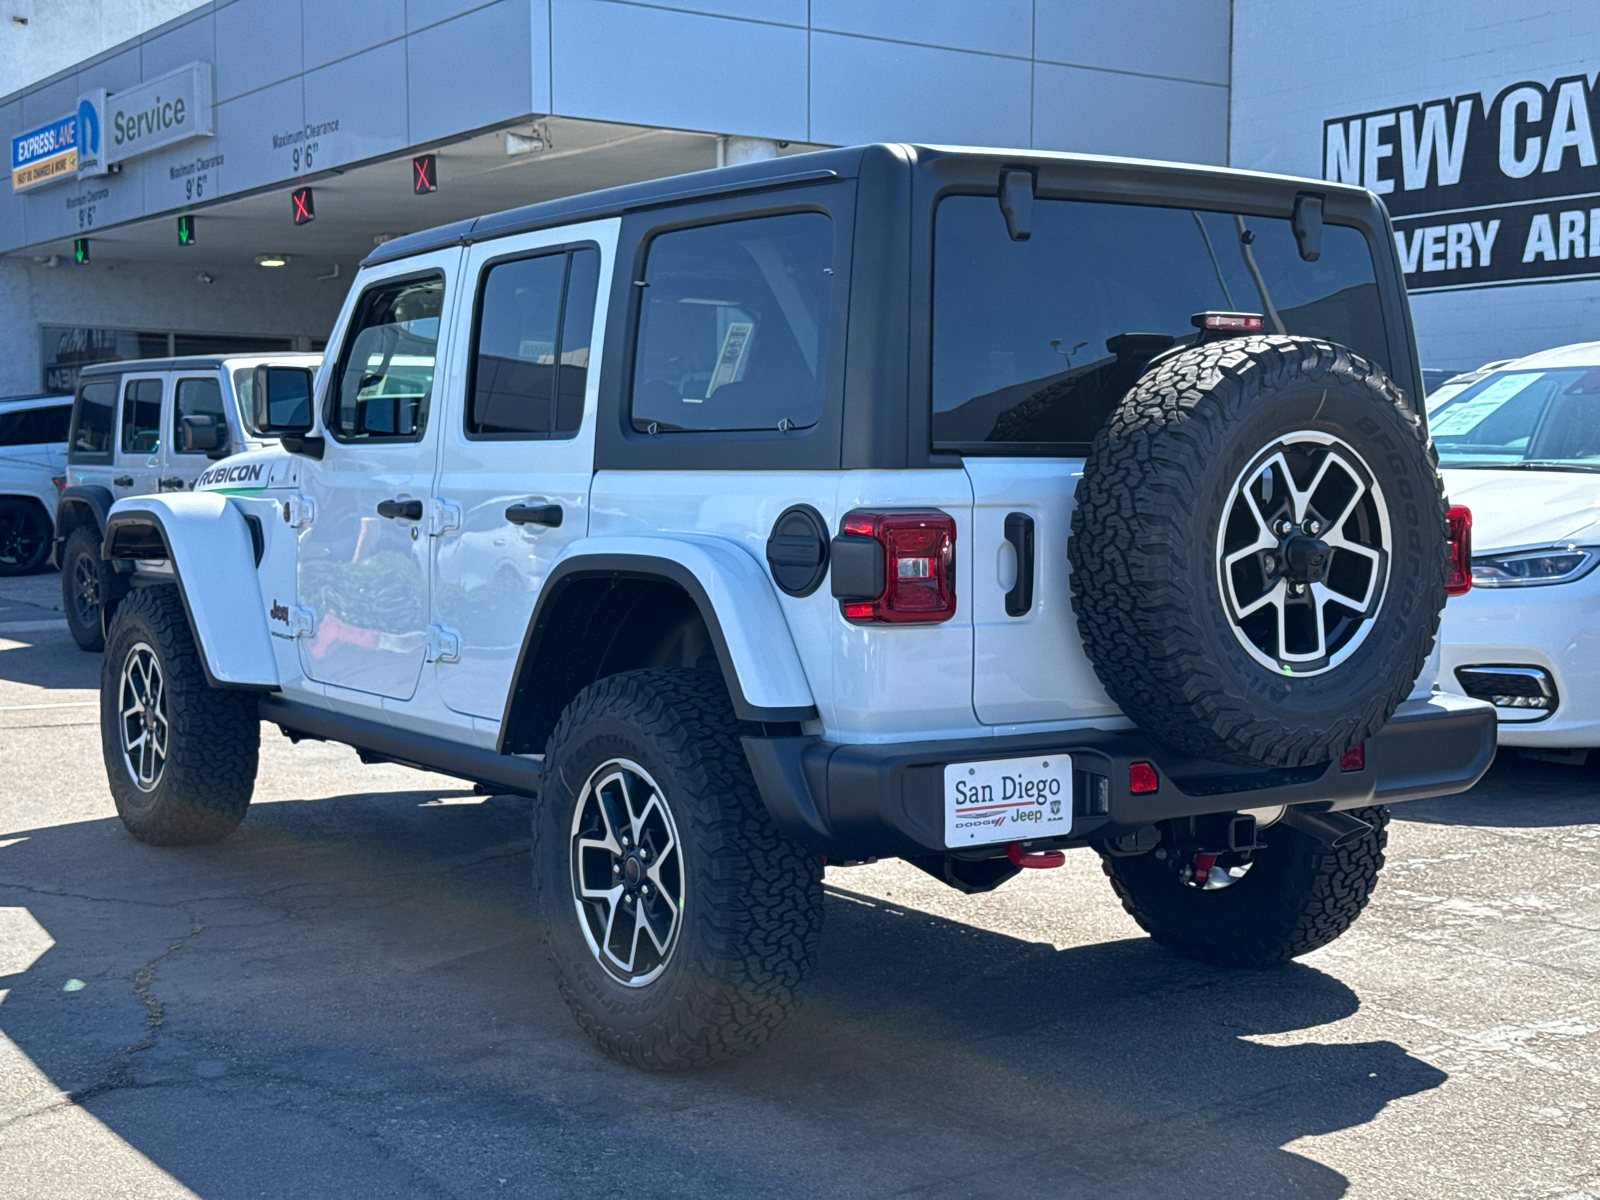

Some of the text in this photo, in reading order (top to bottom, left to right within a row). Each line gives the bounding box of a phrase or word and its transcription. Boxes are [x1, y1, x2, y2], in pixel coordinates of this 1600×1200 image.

[114, 95, 186, 146] Service
[272, 119, 340, 149] Maximum Clearance
[1326, 98, 1474, 195] NEW
[198, 463, 264, 488] RUBICON
[955, 772, 1062, 806] San Diego
[955, 818, 998, 829] DODGE
[1010, 807, 1043, 824] Jeep
